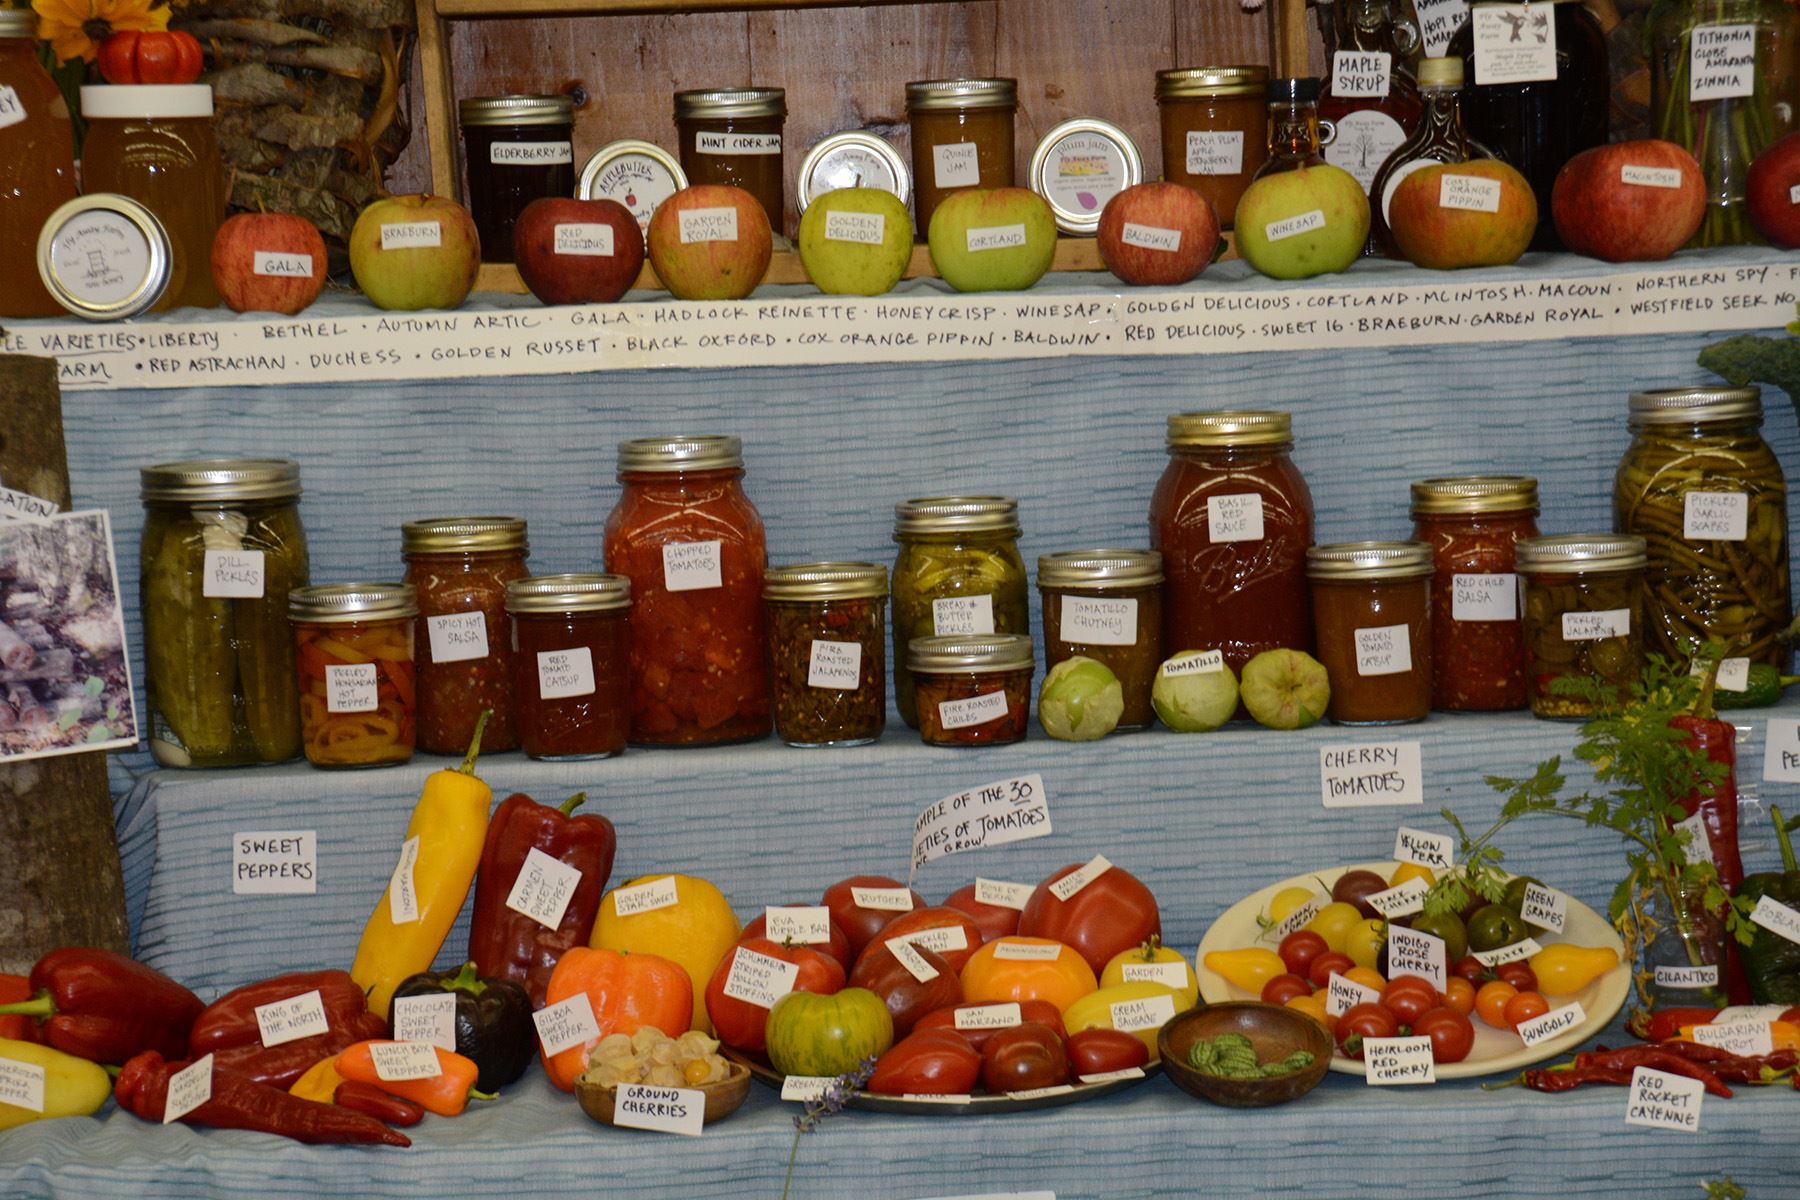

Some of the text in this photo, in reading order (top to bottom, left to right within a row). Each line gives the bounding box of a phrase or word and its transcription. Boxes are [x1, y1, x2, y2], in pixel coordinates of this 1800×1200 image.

[1424, 17, 1447, 37] HOPI
[1697, 30, 1751, 45] TITHONIA
[1694, 46, 1727, 59] GLOBE
[1339, 56, 1382, 74] MAPLE
[1340, 75, 1385, 93] SYRUP
[1694, 74, 1741, 89] ZINNIA
[701, 137, 763, 150] MINT CIDER
[1056, 139, 1109, 158] plum jam
[1189, 135, 1215, 147] PEACH
[493, 147, 556, 159] ELDERBERRY
[946, 162, 967, 173] JAM
[600, 161, 653, 192] APPLEBUTTER
[1449, 185, 1493, 196] ORANGE
[1448, 196, 1484, 207] PIPPIN
[684, 215, 731, 230] GARDEN
[829, 215, 877, 228] GOLDEN
[384, 224, 438, 241] BRAEBURN
[559, 227, 581, 237] RED
[686, 228, 729, 242] ROYAL
[827, 228, 881, 242] DELICIOUS
[1125, 227, 1174, 248] BALDWIN
[556, 238, 606, 250] DELICIOUS
[968, 233, 1023, 249] CORTLAND
[265, 260, 307, 274] GALA
[41, 266, 1769, 351] VARIETIES LIBERTY BETHEL AUTUMN ARTIC GALA HADLOCK REINETTE HONEYCRISP WINESAP GOLDEN DELICIOUS CORTLAND MCINTOSH MACOUN NORTHERN SPY
[59, 292, 1796, 379] ARM RED ASTRACHAN DUCHESS GOLDEN RUSSET BLACK OXFORD COX ORANGE PIPPIN BALDWIN RED DELICIOUS SWEET 16 BRAEBURN GARDEN ROYAL WESTFIELD SEEK NO
[1690, 494, 1738, 508] PICKLED
[1222, 509, 1242, 519] RED
[1692, 507, 1732, 520] GARLIC
[1215, 519, 1247, 534] SAUCE
[667, 544, 711, 558] CHOPPED
[218, 555, 249, 569] DILL
[667, 559, 716, 574] TOMATOES
[215, 569, 259, 586] PICKLES
[1455, 576, 1475, 588] RED
[1457, 589, 1492, 604] SALSA
[937, 600, 966, 611] BREAD
[437, 615, 482, 630] SPICY HOT
[1073, 615, 1123, 635] CHUTNEY
[447, 630, 480, 645] SALSA
[1164, 654, 1220, 673] TOMATILLO
[338, 689, 356, 699] HOT
[1324, 747, 1398, 768] CHERRY
[1325, 771, 1405, 798] TOMATOES
[953, 781, 1033, 810] OF THE 30
[955, 806, 1045, 841] OF TOMATOES
[240, 837, 304, 856] SWEET
[944, 836, 983, 854] GROW
[1400, 833, 1442, 852] YELLOW
[237, 862, 313, 881] PEPPERS
[516, 861, 544, 910] CARMEN
[530, 879, 553, 917] SWEET
[1525, 888, 1556, 907] GREEN
[1525, 904, 1563, 928] GRAPES
[1393, 935, 1431, 949] INDIGO
[1398, 946, 1429, 960] ROSE
[1124, 967, 1164, 978] GARDEN
[1391, 957, 1440, 980] CHERRY
[1657, 970, 1716, 984] CILANTRO
[1330, 981, 1362, 1004] HONEY
[261, 1002, 302, 1022] KING OF
[539, 1005, 573, 1027] GILBOA
[1113, 1002, 1147, 1017] CREAM
[264, 1009, 322, 1036] THE NORTH
[400, 1014, 436, 1028] SWEET
[1523, 1011, 1575, 1042] SUNGOLD
[400, 1026, 444, 1041] PEPPER
[1696, 1020, 1767, 1042] BULGARIAN
[1370, 1042, 1431, 1057] HEIRLOOM
[386, 1063, 437, 1077] PEPPERS
[1373, 1057, 1397, 1069] RED
[1377, 1063, 1429, 1079] CHERRY
[1637, 1075, 1663, 1090] RED
[627, 1087, 680, 1102] GROUND
[1639, 1089, 1691, 1107] ROCKET
[622, 1101, 688, 1118] CHERRIES
[1629, 1106, 1695, 1126] CAYENNE
